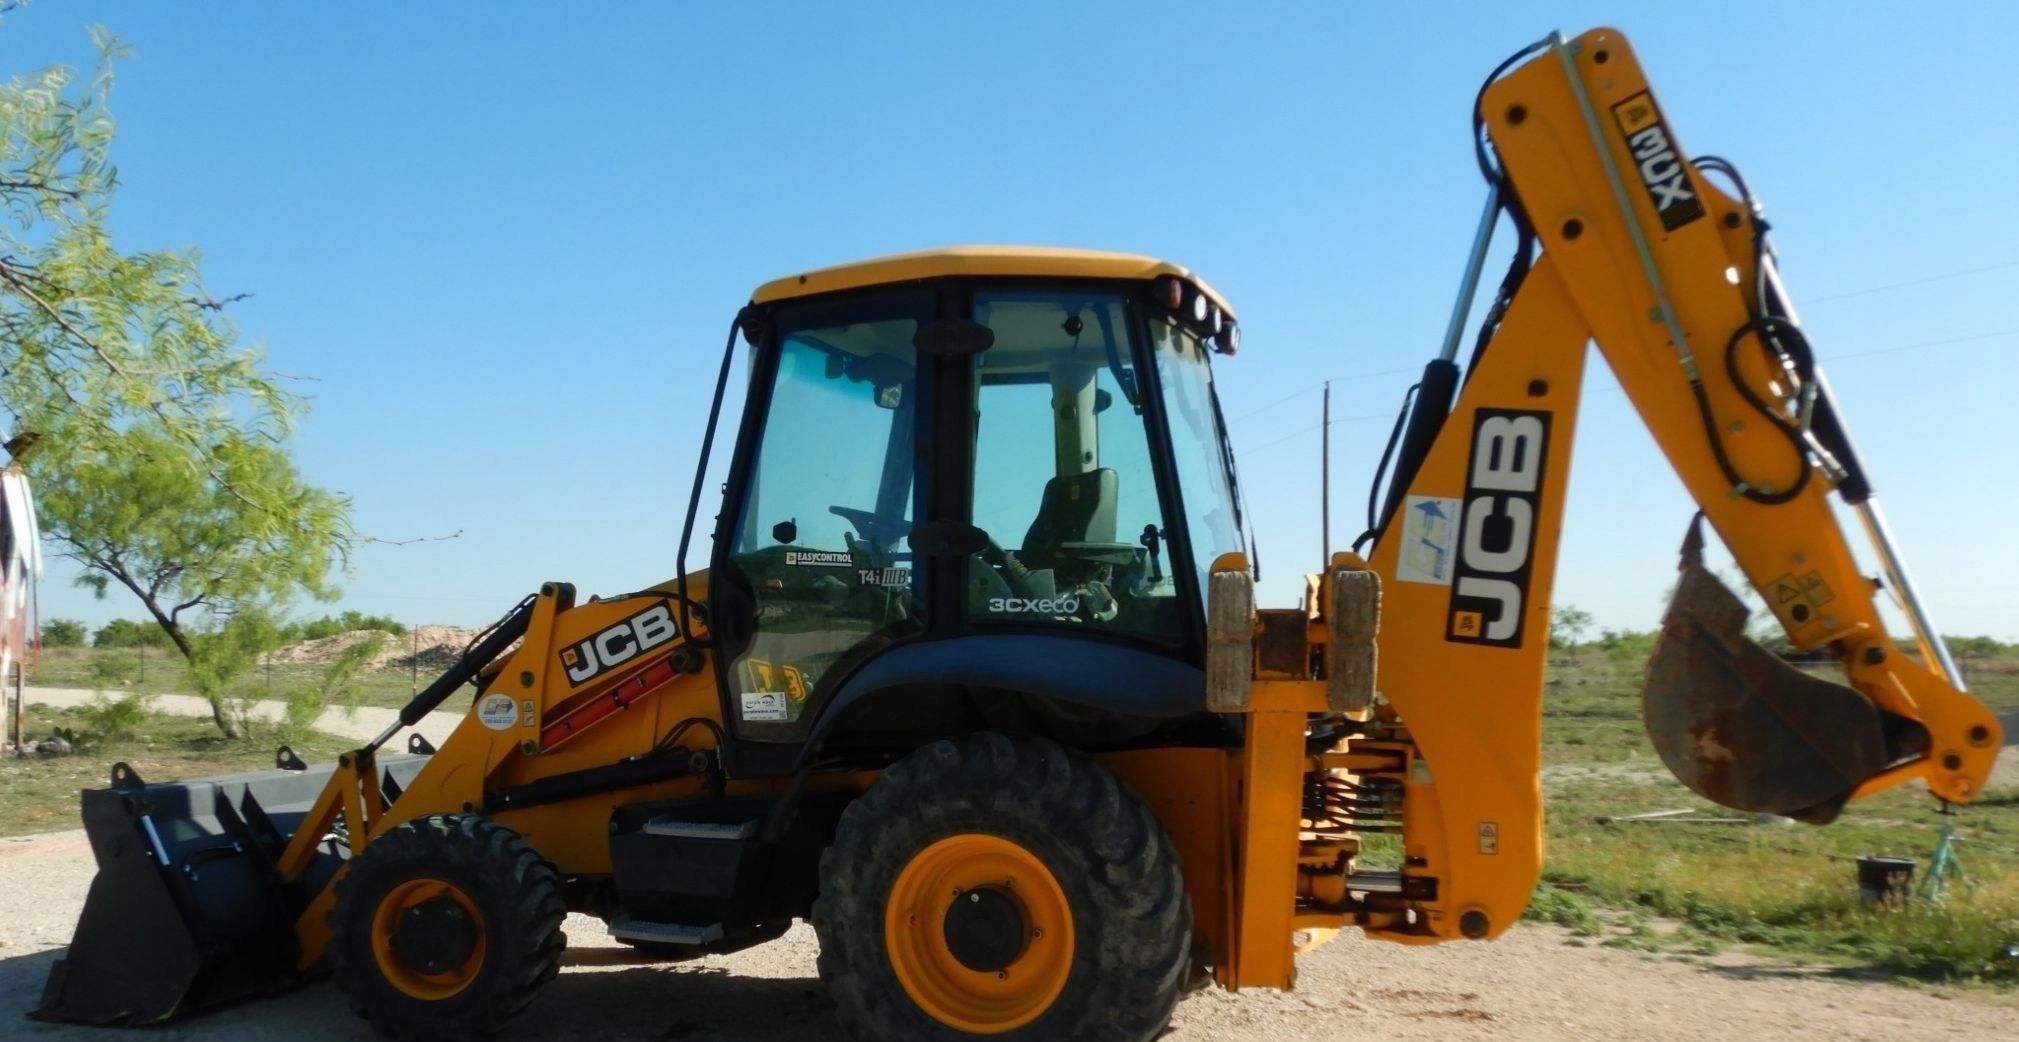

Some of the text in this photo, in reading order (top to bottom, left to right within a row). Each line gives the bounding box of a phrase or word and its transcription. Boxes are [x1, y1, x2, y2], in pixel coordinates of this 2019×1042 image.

[1630, 125, 1695, 212] 3CX
[797, 552, 853, 564] EASYCONTROL
[1457, 415, 1543, 641] JCB
[568, 605, 677, 682] JCB
[989, 597, 1080, 614] 3CXeco
